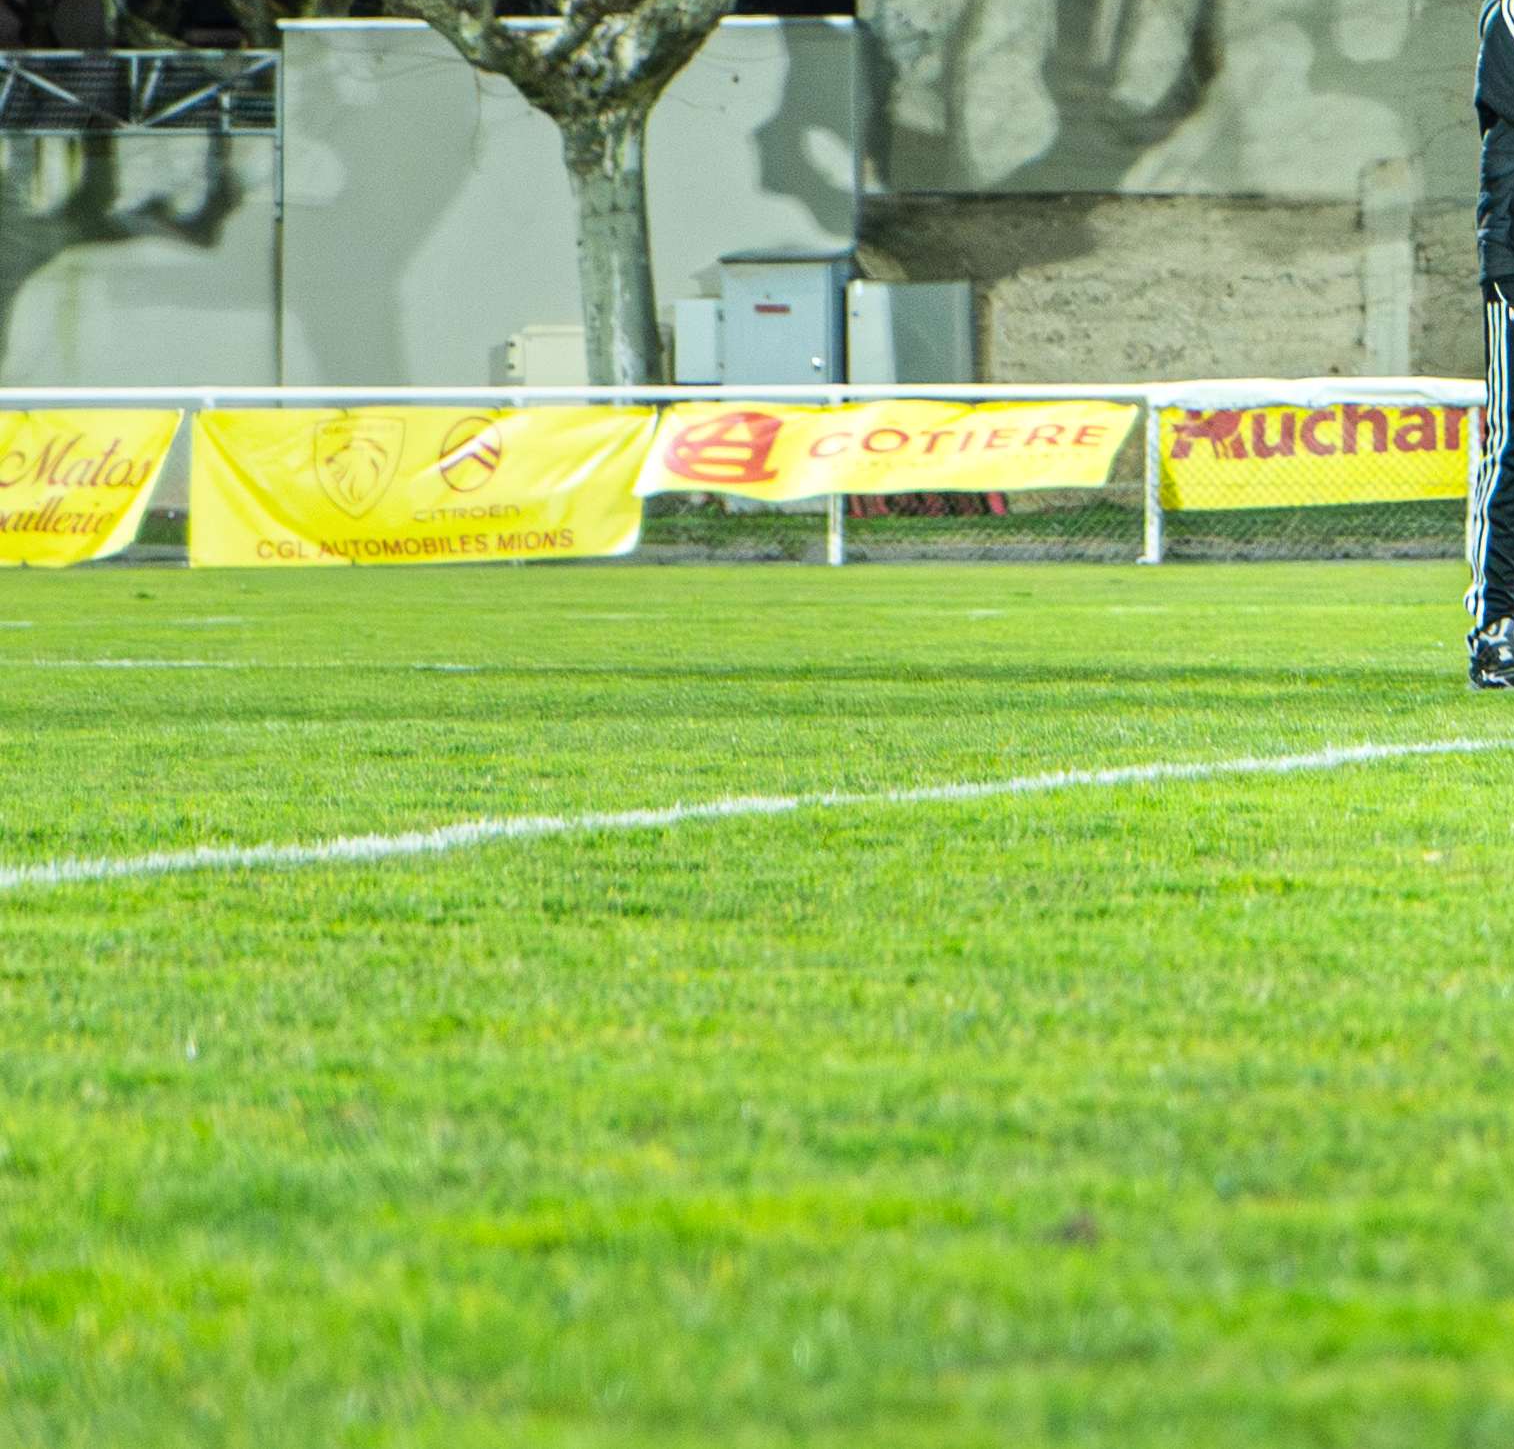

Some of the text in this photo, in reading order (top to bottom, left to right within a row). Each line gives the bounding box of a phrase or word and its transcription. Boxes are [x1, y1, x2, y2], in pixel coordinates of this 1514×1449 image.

[256, 528, 575, 560] CGL AUTOMOBILES MIONS
